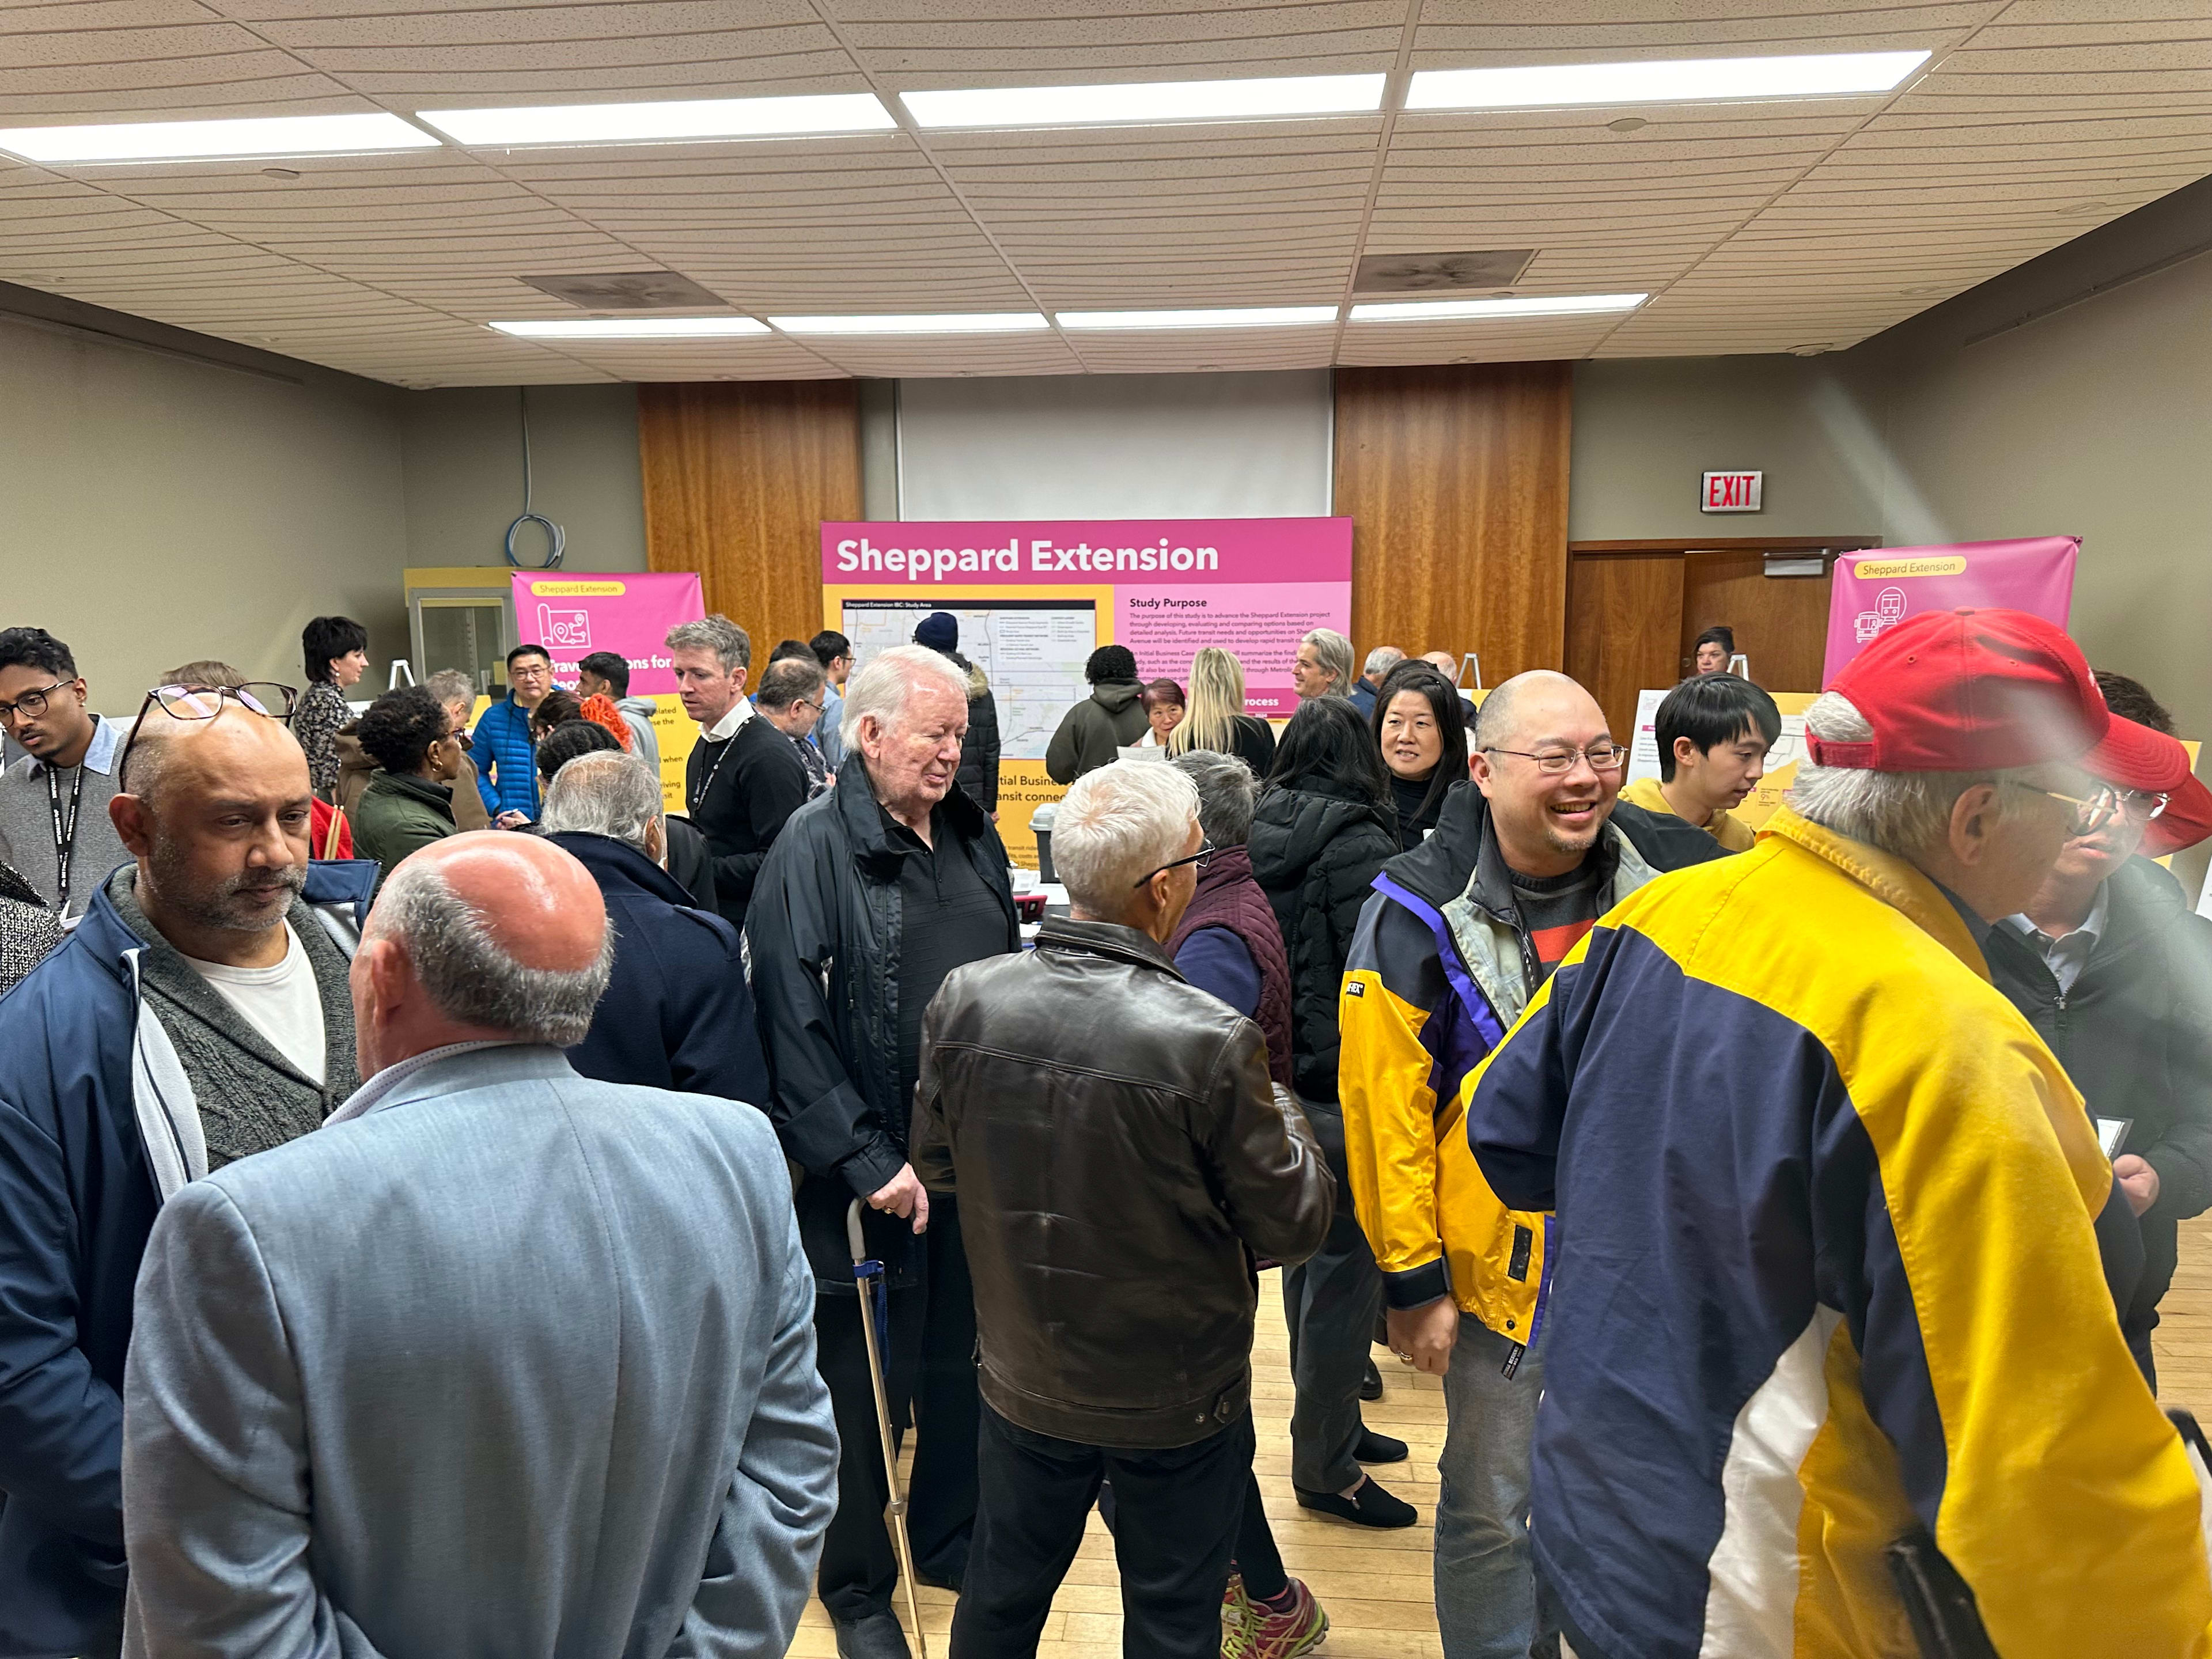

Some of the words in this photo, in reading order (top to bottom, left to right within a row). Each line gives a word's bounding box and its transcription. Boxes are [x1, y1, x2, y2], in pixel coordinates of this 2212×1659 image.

[1709, 475, 1755, 507] EXIT
[836, 539, 1019, 581] Sheppard
[1031, 539, 1218, 571] Extension
[1863, 563, 1907, 576] Sheppard
[1910, 562, 1955, 572] Extension
[540, 586, 578, 594] Sheppard
[1130, 599, 1160, 609] Study
[1164, 599, 1207, 609] Purpose
[627, 657, 649, 669] ons
[651, 655, 672, 669] for
[1245, 698, 1279, 706] rocess
[1000, 775, 1016, 785] tial
[1020, 776, 1057, 786] Busine
[997, 791, 1022, 801] ansit
